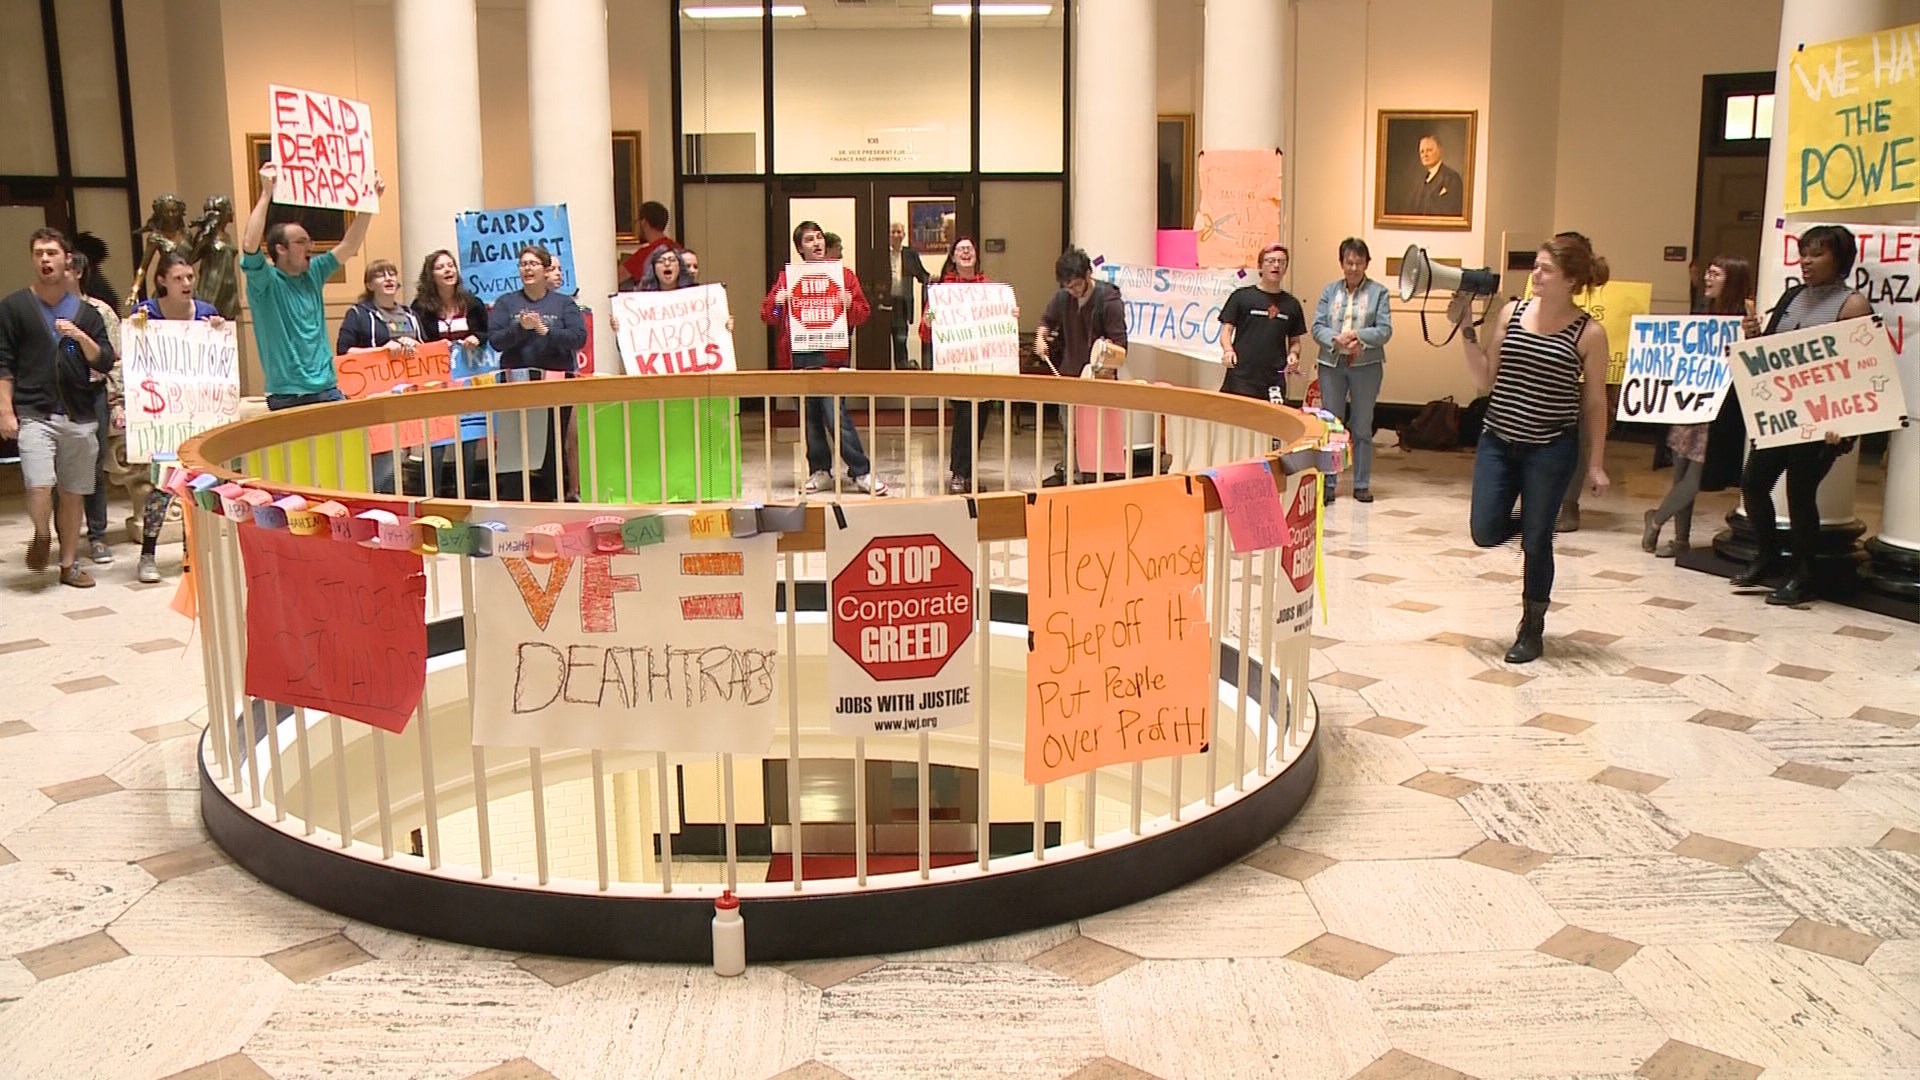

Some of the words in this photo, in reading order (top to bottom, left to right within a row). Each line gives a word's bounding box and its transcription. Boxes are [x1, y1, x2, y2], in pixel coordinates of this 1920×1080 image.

[1794, 45, 1859, 101] WE
[1872, 30, 1920, 88] HA
[1836, 99, 1892, 136] THE
[277, 133, 366, 175] DEATH
[477, 210, 545, 235] CARDS
[624, 297, 717, 327] SWEATSHOP
[1635, 321, 1681, 345] THE
[132, 335, 236, 378] MILLION
[630, 320, 716, 353] LABOR
[1739, 335, 1838, 377] WORKER
[339, 353, 450, 398] STUDENTS
[635, 343, 723, 375] KILLS
[1629, 347, 1675, 378] WORK
[1773, 358, 1852, 403] SAFETY
[1857, 357, 1877, 371] AND
[1623, 378, 1674, 416] CUT
[1754, 410, 1799, 436] FAIR
[1804, 391, 1879, 423] WAGES
[867, 545, 941, 587] STOP
[1048, 499, 1116, 608] Hey
[501, 546, 642, 633] VF
[837, 592, 969, 625] Corporate
[860, 621, 948, 664] GREED
[1046, 611, 1106, 675] Step
[836, 696, 872, 713] JOBS
[877, 693, 915, 712] WITH
[919, 687, 971, 710] JUSTICE
[1037, 680, 1091, 727] Put
[1104, 665, 1166, 703] People
[874, 716, 938, 731] www.jwj.org
[1116, 706, 1206, 751] Profit!
